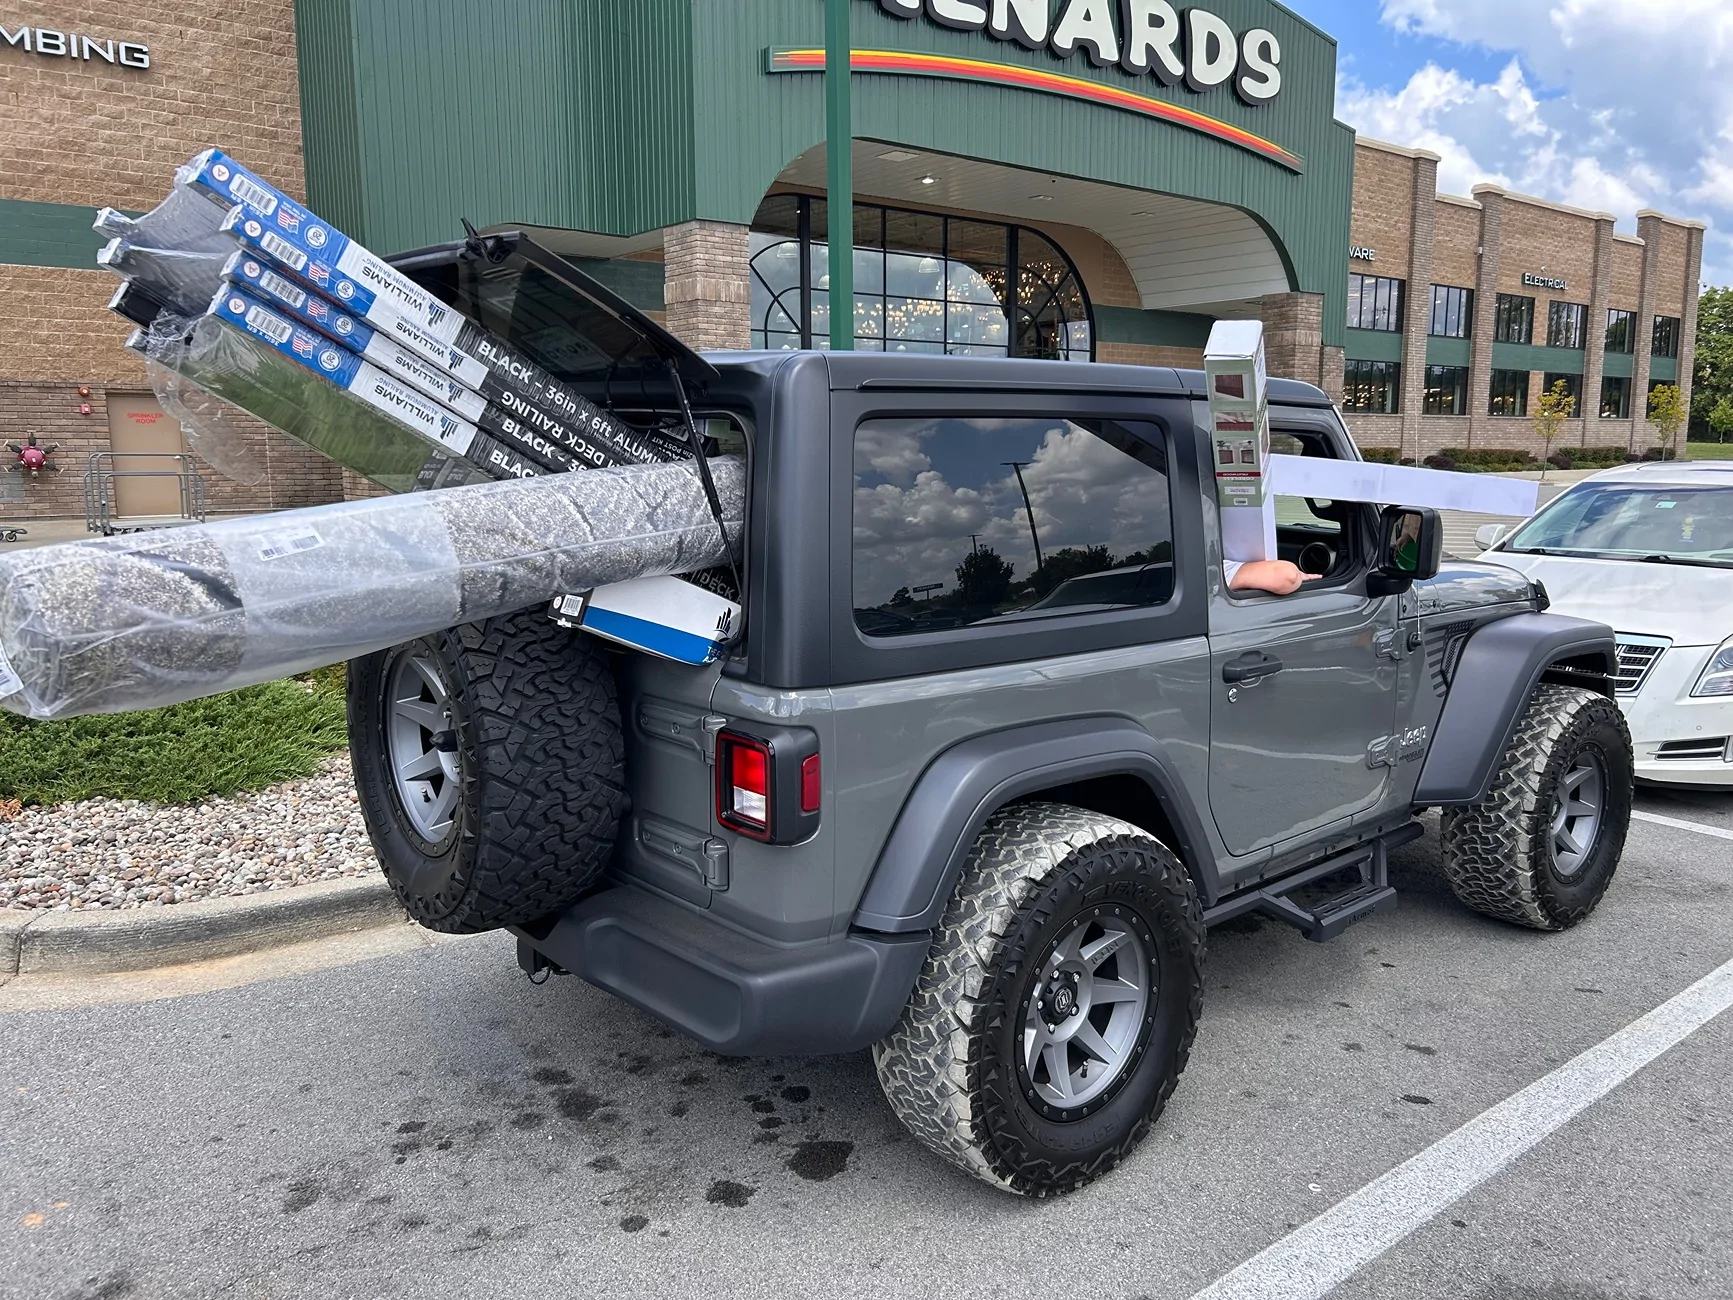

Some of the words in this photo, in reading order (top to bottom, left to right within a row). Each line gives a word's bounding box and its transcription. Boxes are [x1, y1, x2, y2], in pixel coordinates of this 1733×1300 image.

[882, 0, 1281, 103] NARDS
[312, 230, 322, 240] 20
[361, 265, 423, 311] WILLIAMS
[389, 274, 428, 302] ALUMINUM
[394, 319, 447, 358] WILLIAMS
[325, 354, 336, 363] 20
[394, 353, 445, 391] WILLIAMS
[373, 383, 435, 425] WILLIAMS
[404, 392, 439, 415] ALUMINUM
[476, 340, 534, 383] BLACK
[543, 385, 578, 414] 36in
[589, 415, 615, 437] 6ft
[498, 389, 564, 438] RAILING
[501, 417, 556, 458] BLACK
[563, 431, 605, 465] DECK
[651, 436, 663, 444] KIT
[663, 442, 681, 453] POST
[1400, 726, 1426, 747] Jeep
[1091, 941, 1119, 965] ICON
